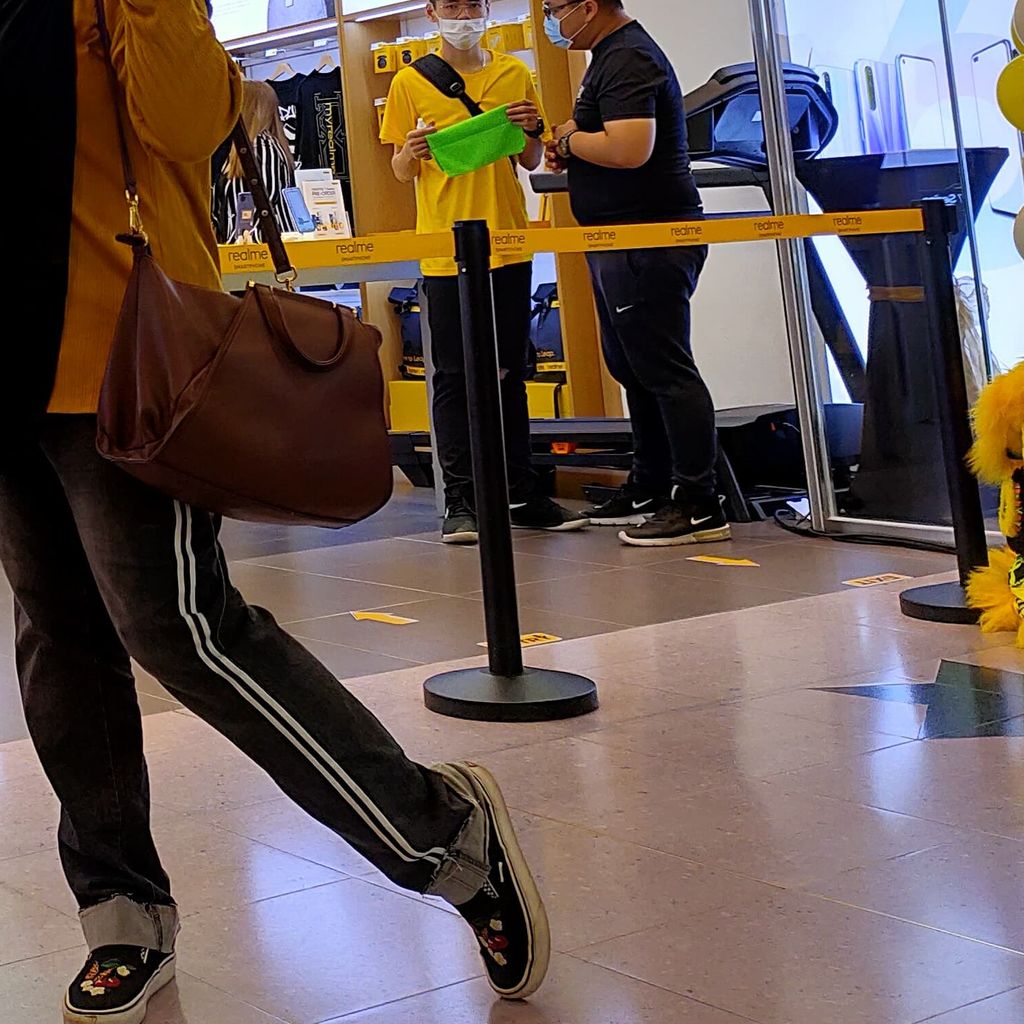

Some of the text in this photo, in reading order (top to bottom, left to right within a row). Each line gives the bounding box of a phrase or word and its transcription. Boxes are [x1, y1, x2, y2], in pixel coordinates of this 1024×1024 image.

[754, 219, 785, 231] realme
[833, 215, 863, 226] realme
[583, 229, 616, 242] realme
[670, 224, 702, 237] realme
[491, 232, 526, 245] realme
[335, 241, 374, 255] realme
[228, 248, 269, 262] realme
